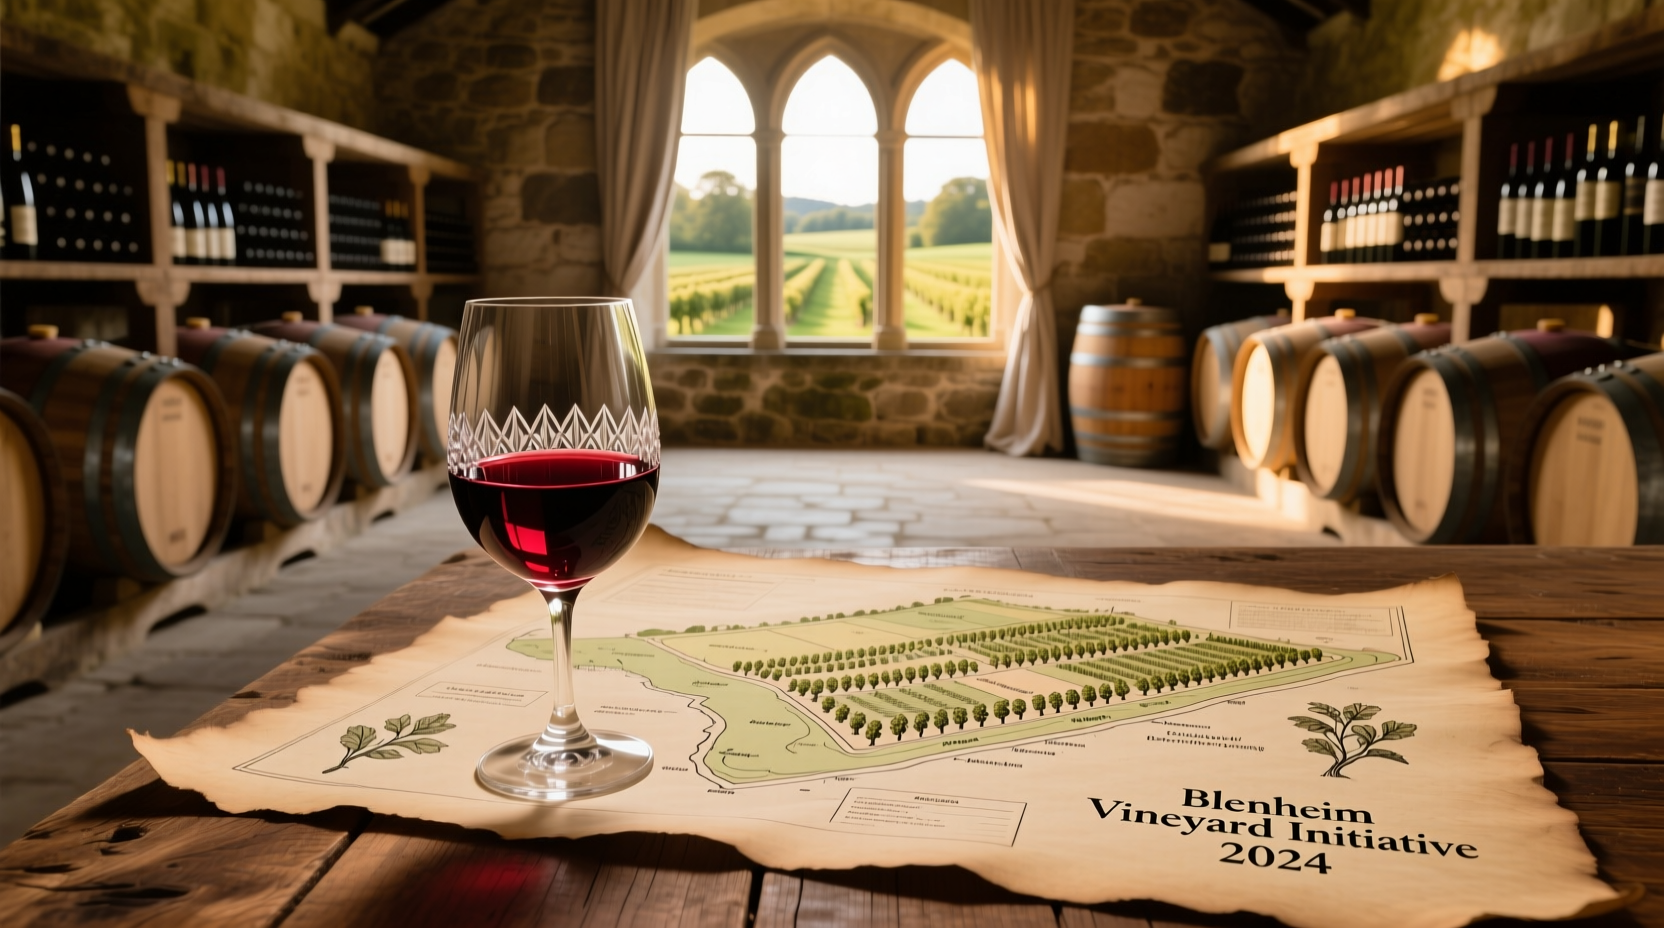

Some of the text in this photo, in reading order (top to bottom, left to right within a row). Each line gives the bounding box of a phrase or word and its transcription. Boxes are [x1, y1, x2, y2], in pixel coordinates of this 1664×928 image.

[1182, 788, 1375, 825] Blenheim
[1087, 797, 1480, 860] Vineyard Initiative
[1219, 841, 1332, 874] 2024
